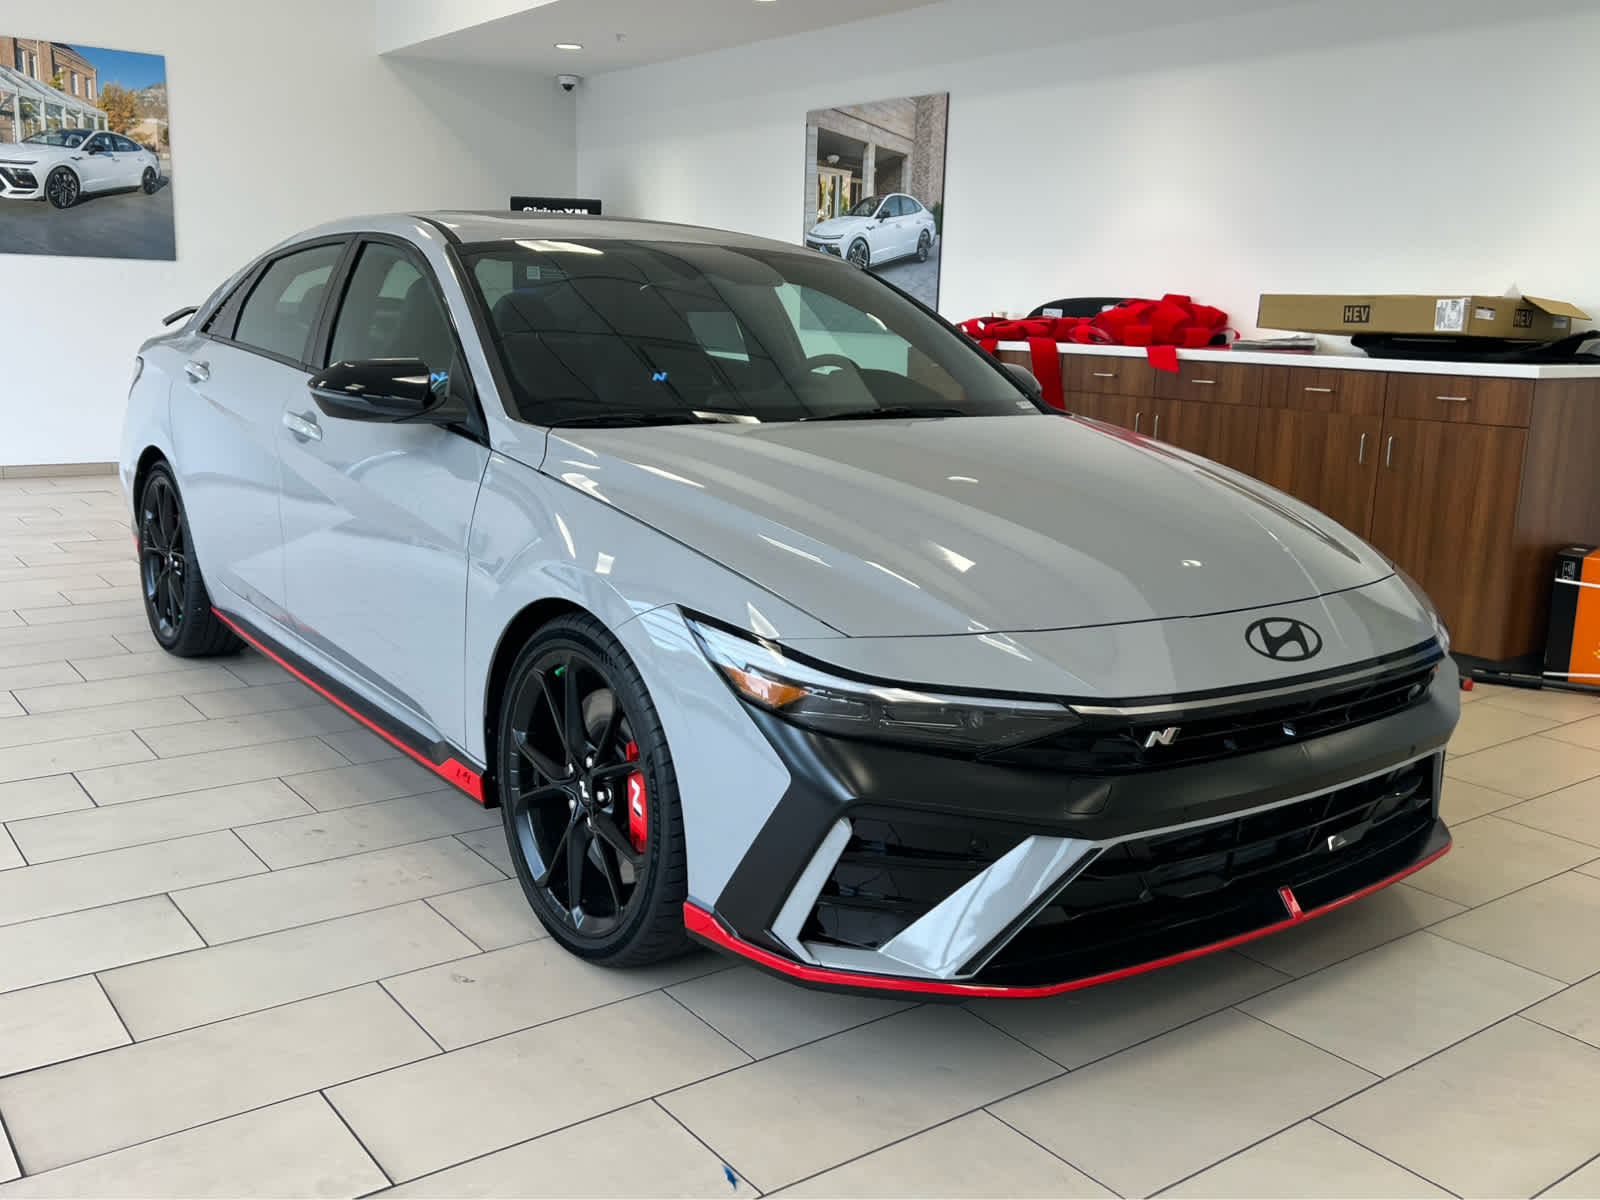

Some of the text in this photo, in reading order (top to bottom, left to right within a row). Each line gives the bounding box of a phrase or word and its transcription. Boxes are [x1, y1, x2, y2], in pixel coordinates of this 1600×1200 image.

[1344, 306, 1369, 321] HEV
[652, 371, 668, 382] N
[1144, 726, 1181, 748] N
[631, 778, 643, 817] N
